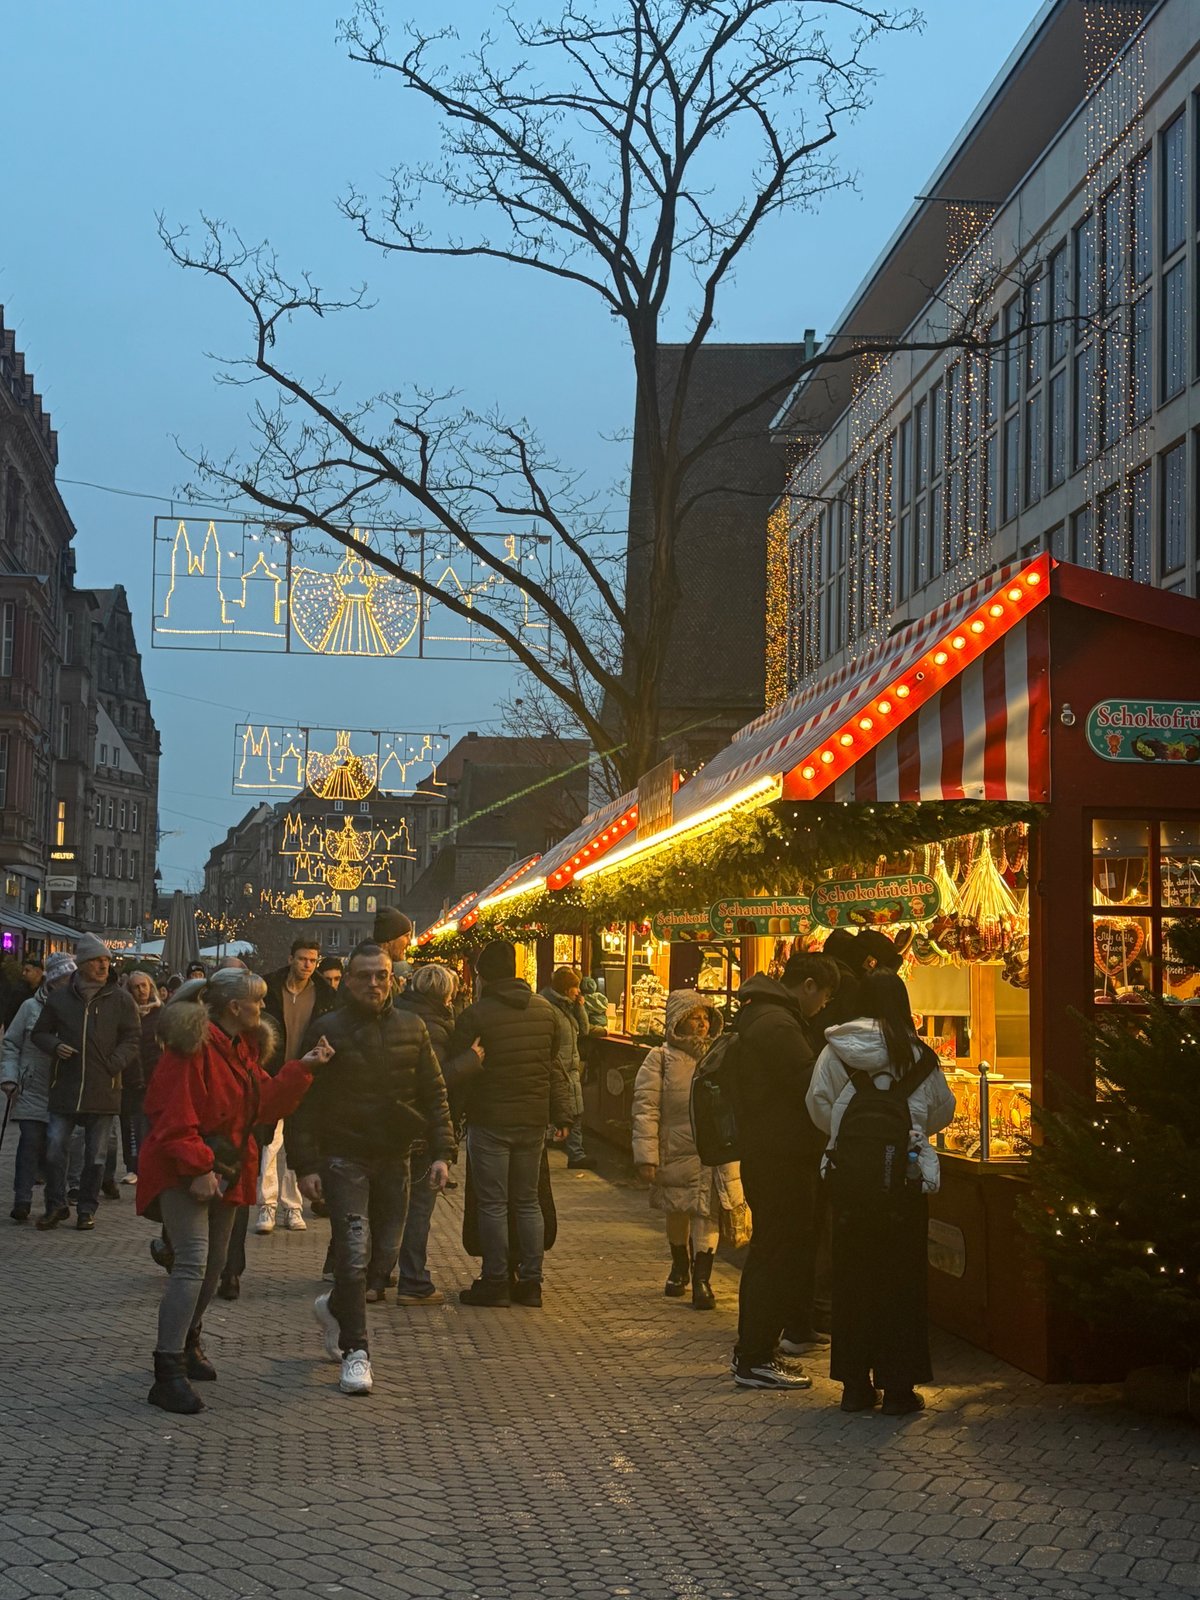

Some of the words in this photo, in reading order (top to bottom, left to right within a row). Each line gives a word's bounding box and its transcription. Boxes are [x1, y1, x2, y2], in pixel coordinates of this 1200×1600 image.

[1097, 705, 1200, 730] Schokofrü
[51, 852, 75, 860] MELTER
[816, 879, 934, 904] Schokofrüchte
[1097, 932, 1113, 945] My
[1102, 943, 1127, 952] Quee
